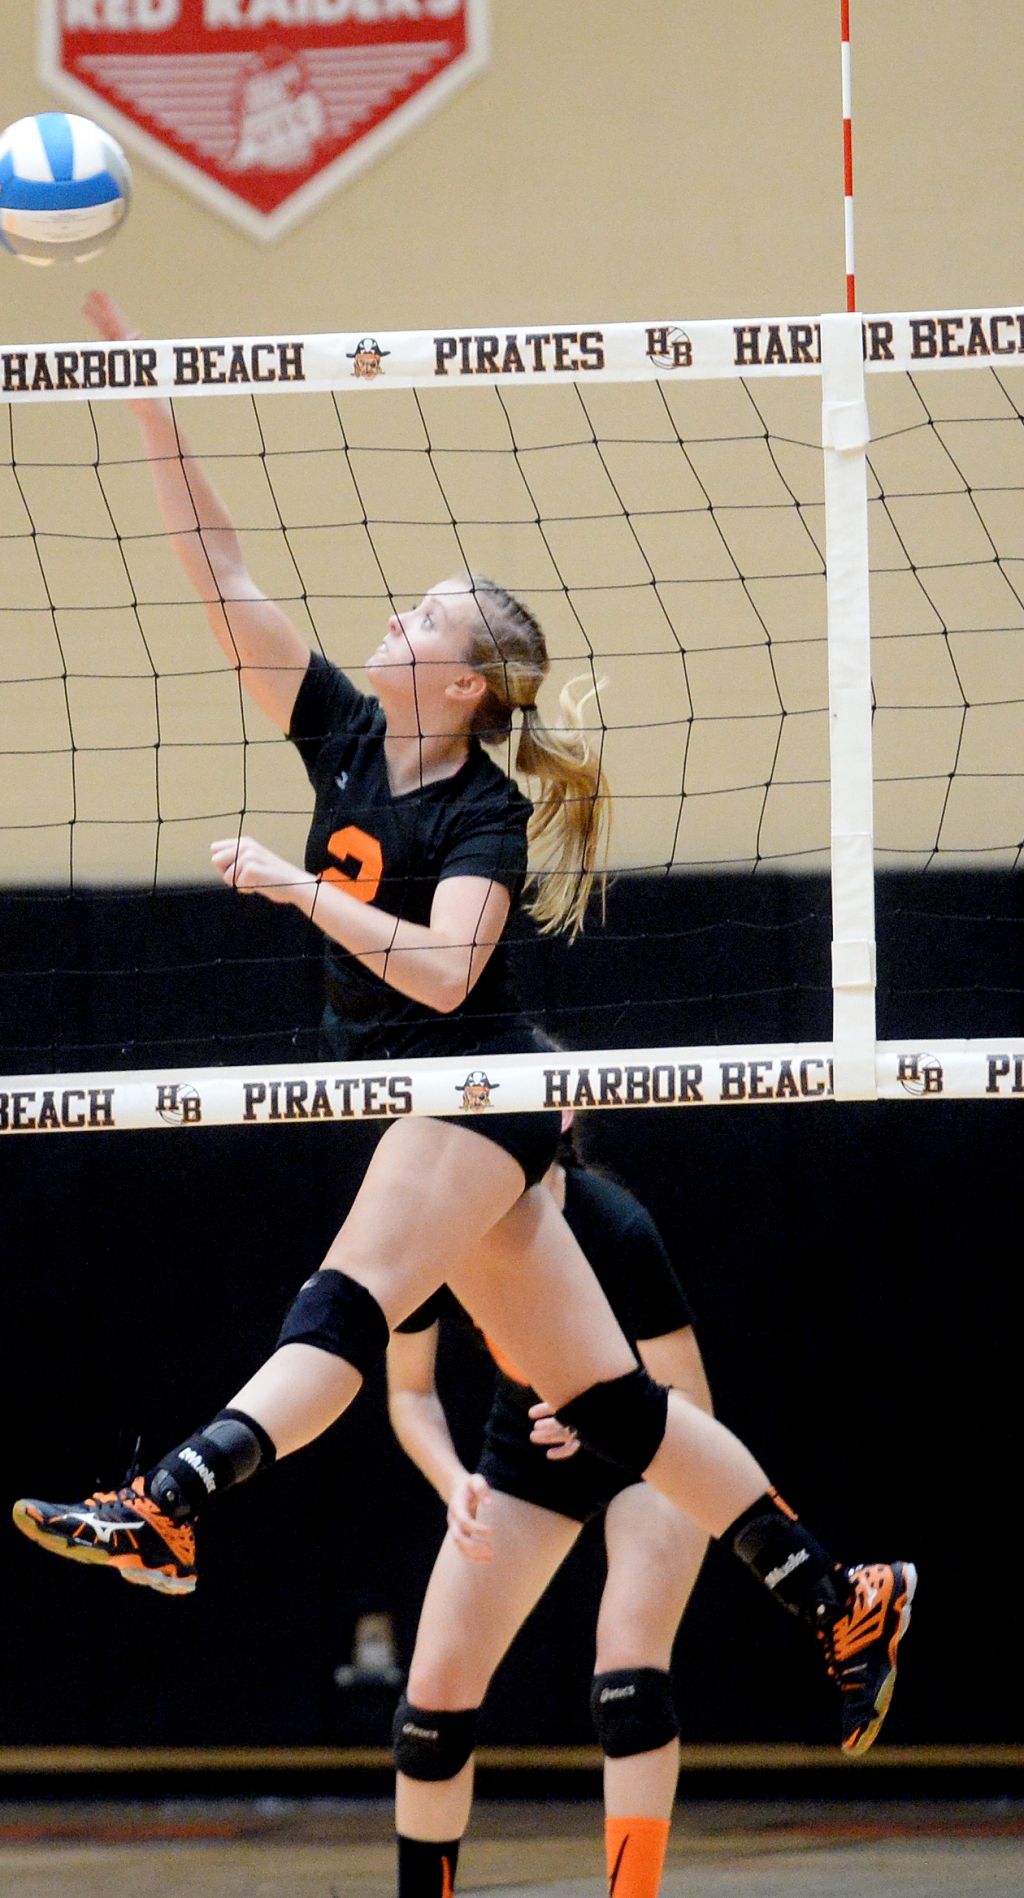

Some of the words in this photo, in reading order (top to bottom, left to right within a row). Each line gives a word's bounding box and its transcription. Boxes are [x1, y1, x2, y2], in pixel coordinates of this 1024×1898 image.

[1, 347, 159, 392] HARBOR
[173, 341, 307, 385] BEACH
[433, 331, 605, 376] PIRATES
[733, 320, 895, 365] HARR
[243, 1077, 413, 1120] PIRATES
[543, 1063, 704, 1108] HARBOR
[719, 1058, 834, 1101] BEAC
